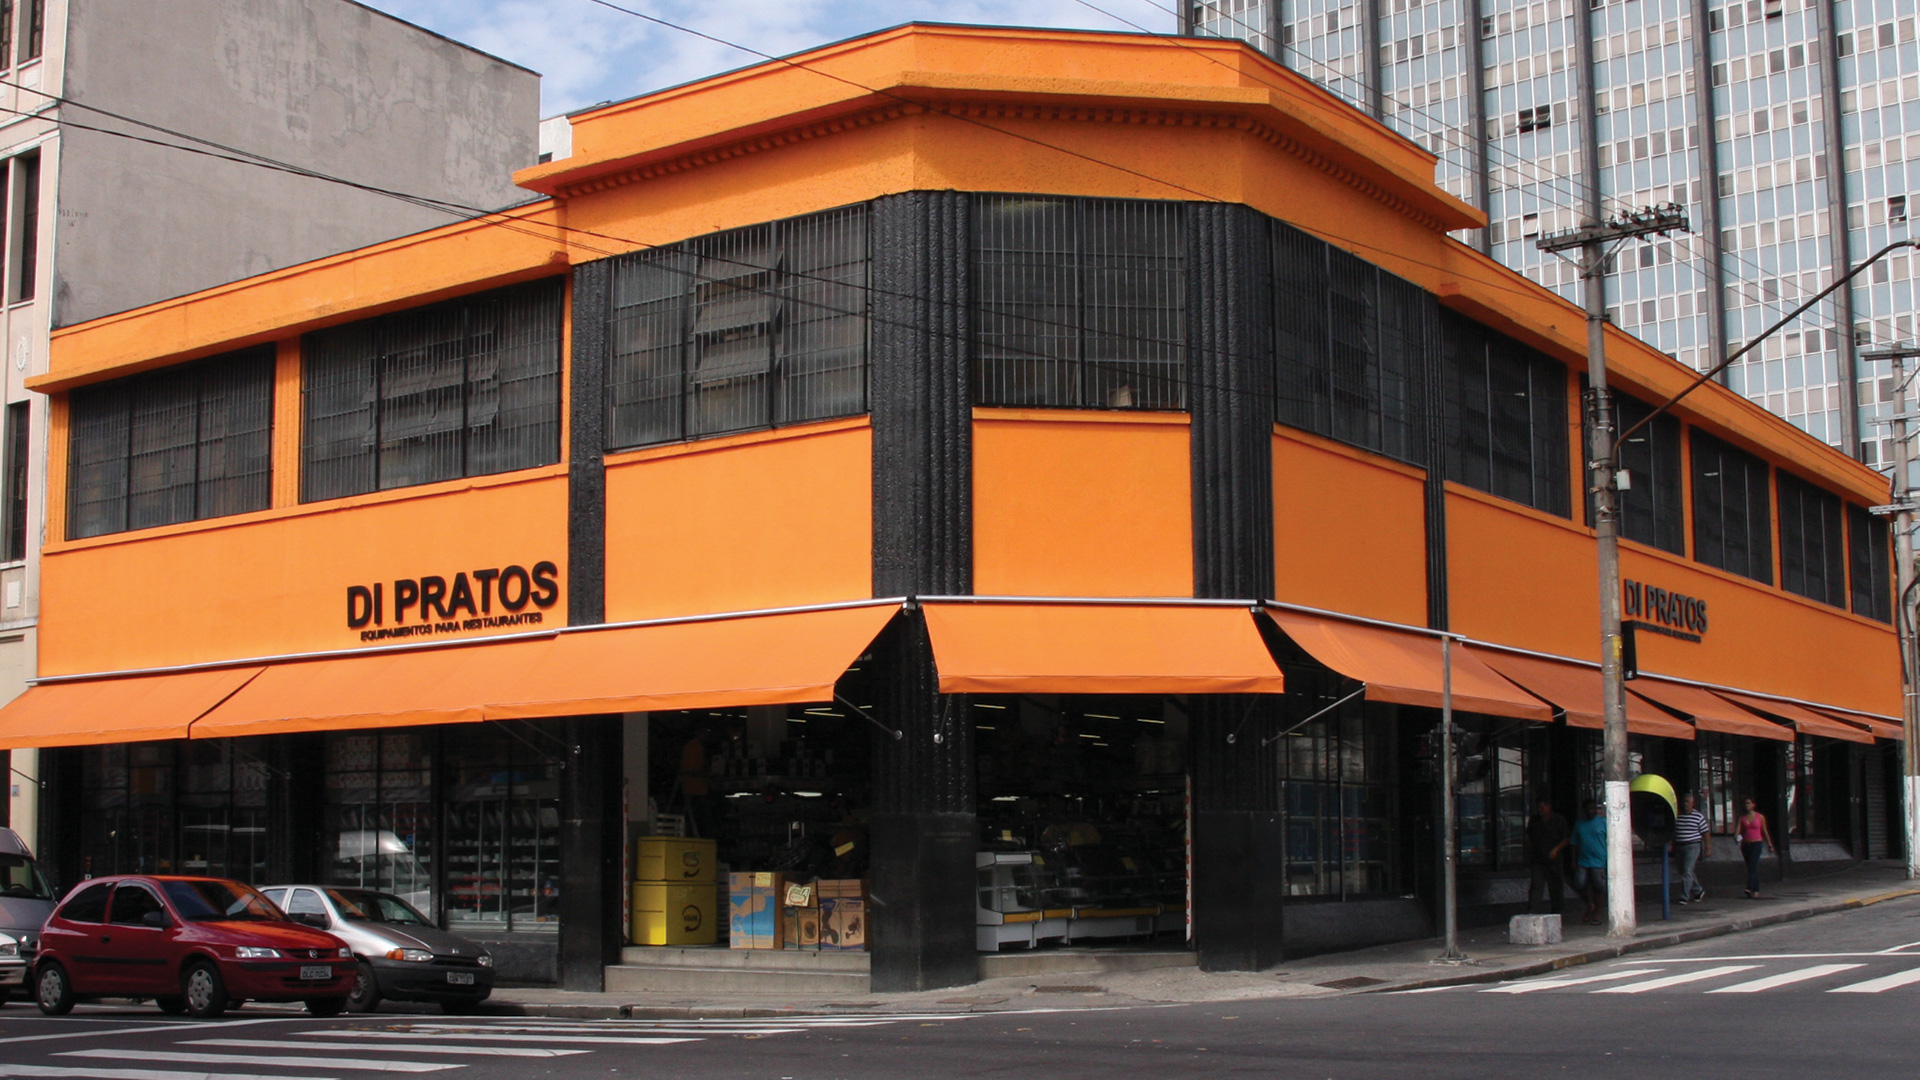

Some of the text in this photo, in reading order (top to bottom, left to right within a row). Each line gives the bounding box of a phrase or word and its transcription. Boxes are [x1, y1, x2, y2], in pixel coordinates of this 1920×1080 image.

[347, 560, 559, 628] DI PRATOS
[1624, 578, 1642, 617] DI
[1645, 585, 1707, 633] PRATOS
[360, 612, 543, 642] EQUIPAMENTOS PARA RESTAURANTES
